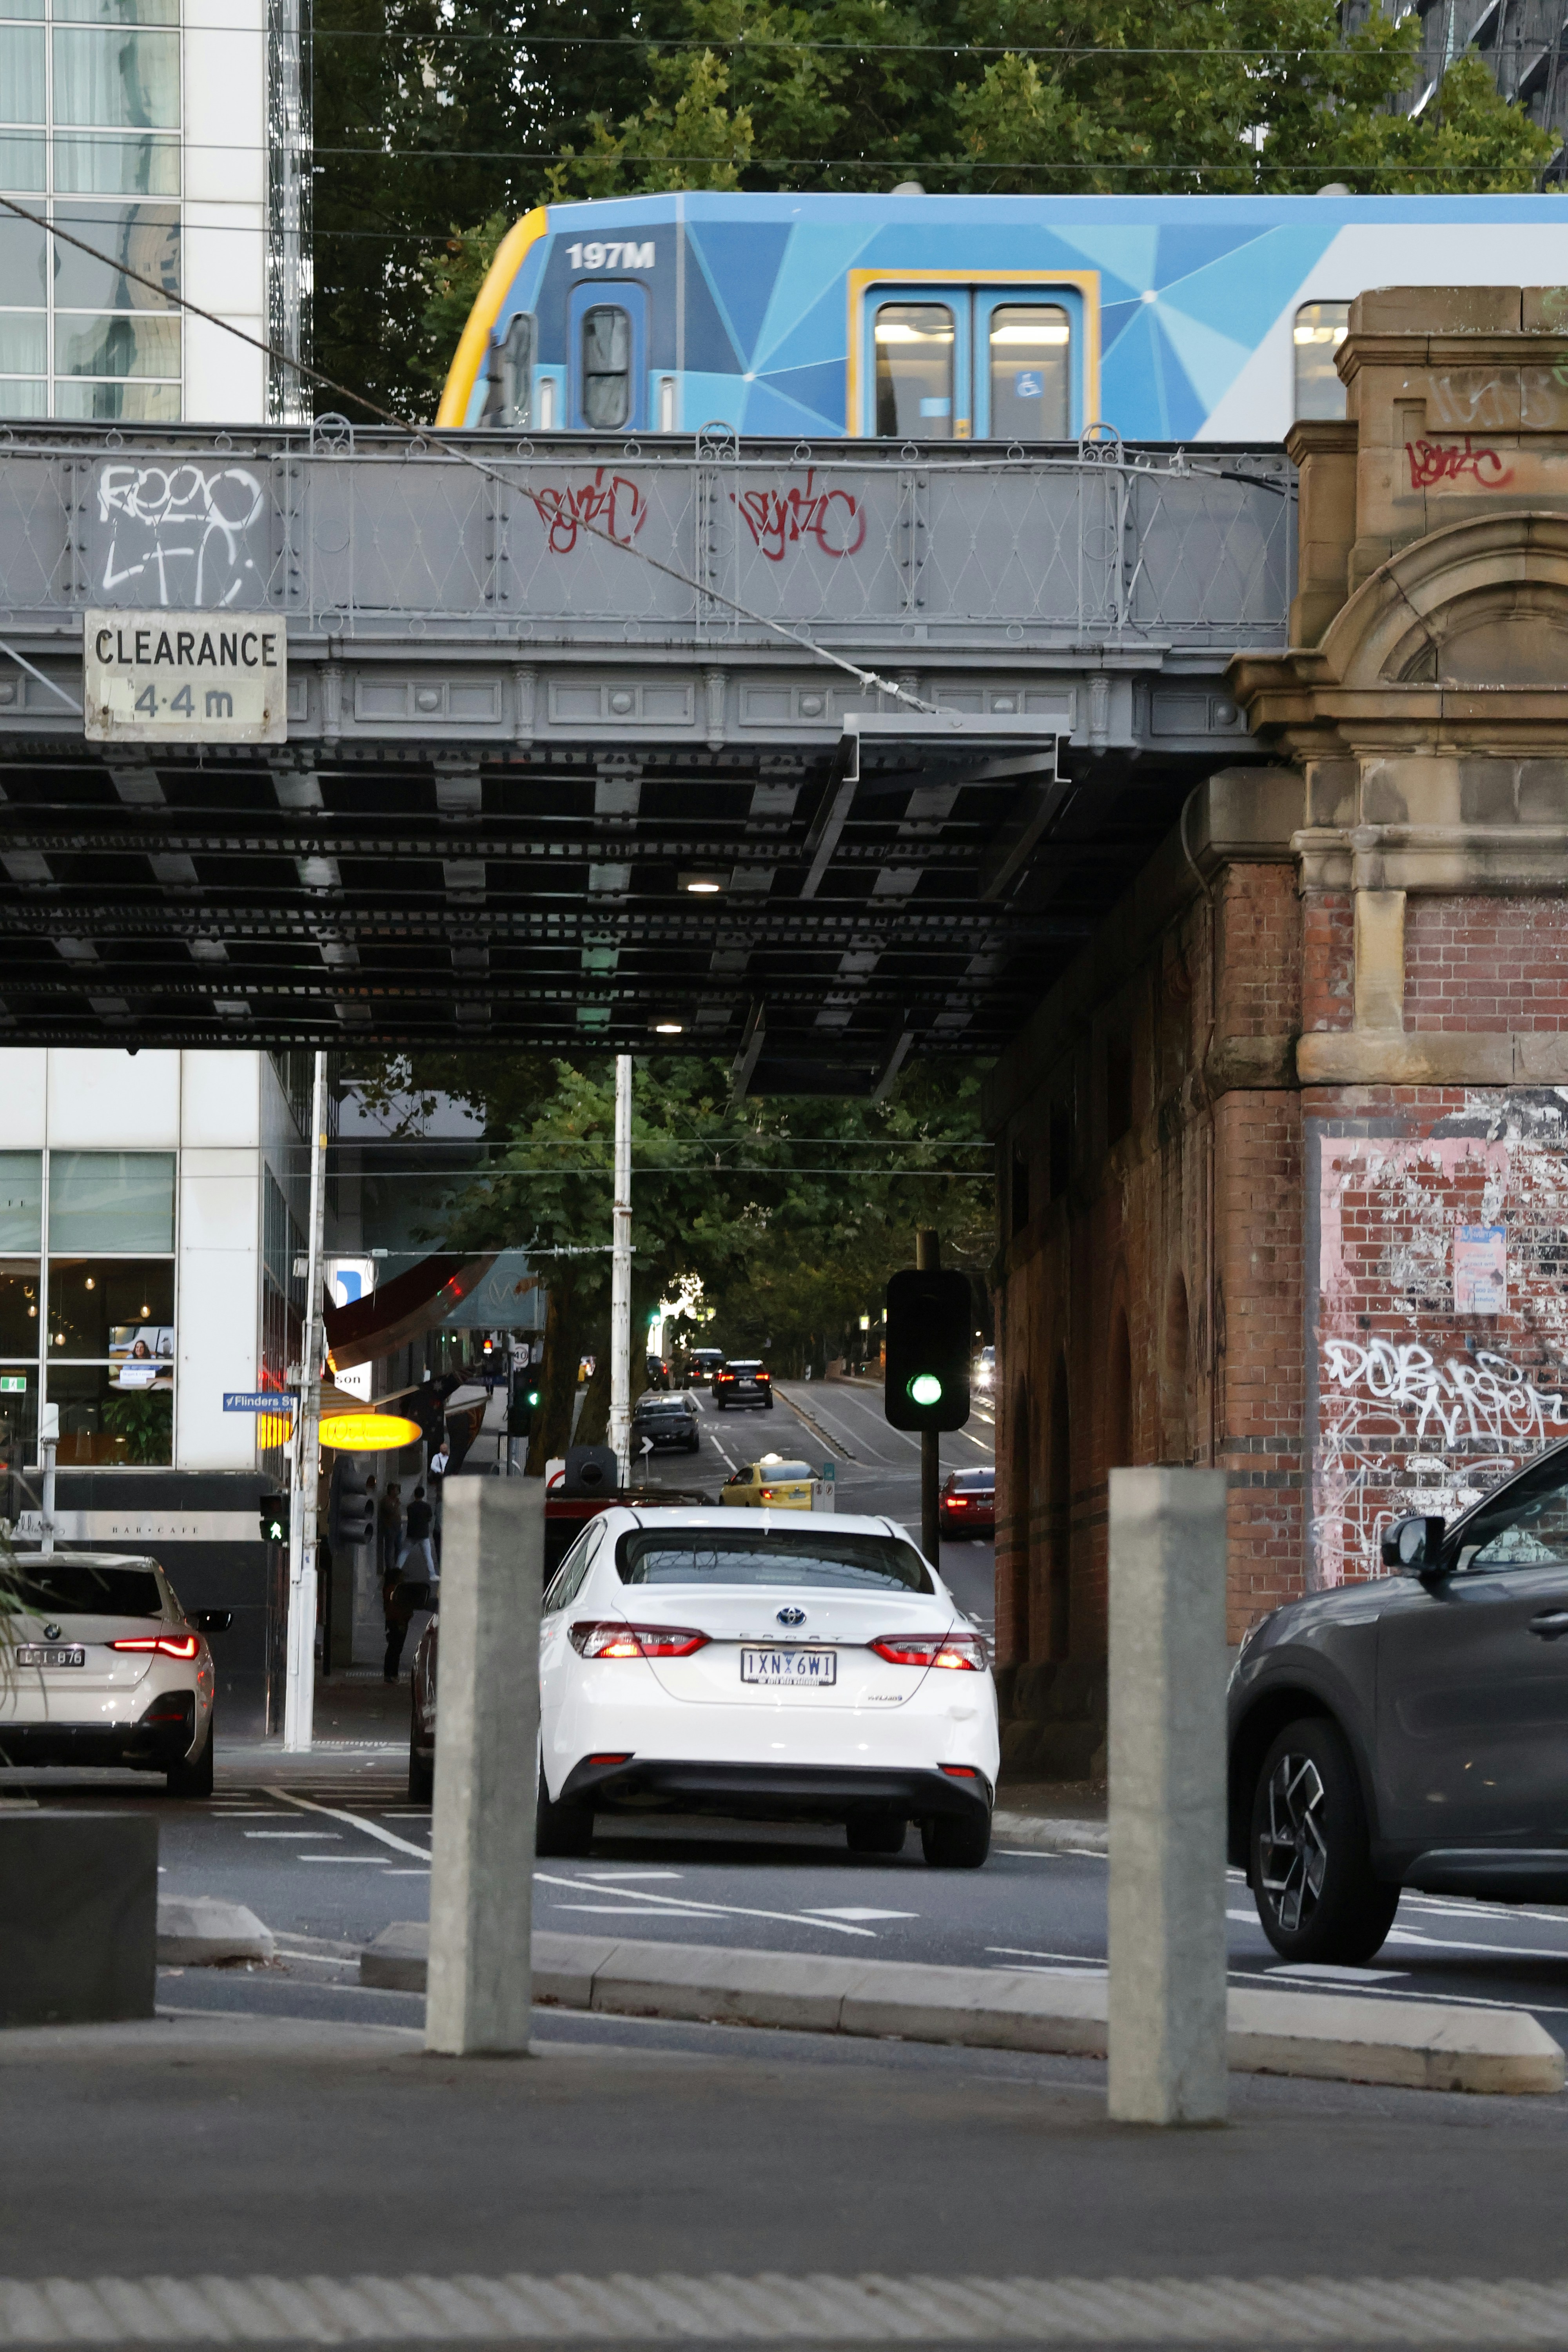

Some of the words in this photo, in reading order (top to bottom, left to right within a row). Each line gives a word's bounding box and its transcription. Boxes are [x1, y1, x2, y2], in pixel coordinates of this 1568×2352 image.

[565, 242, 655, 269] 197M
[96, 630, 277, 666] CLEARANCE
[205, 690, 233, 717] m
[235, 1394, 279, 1406] Flinders
